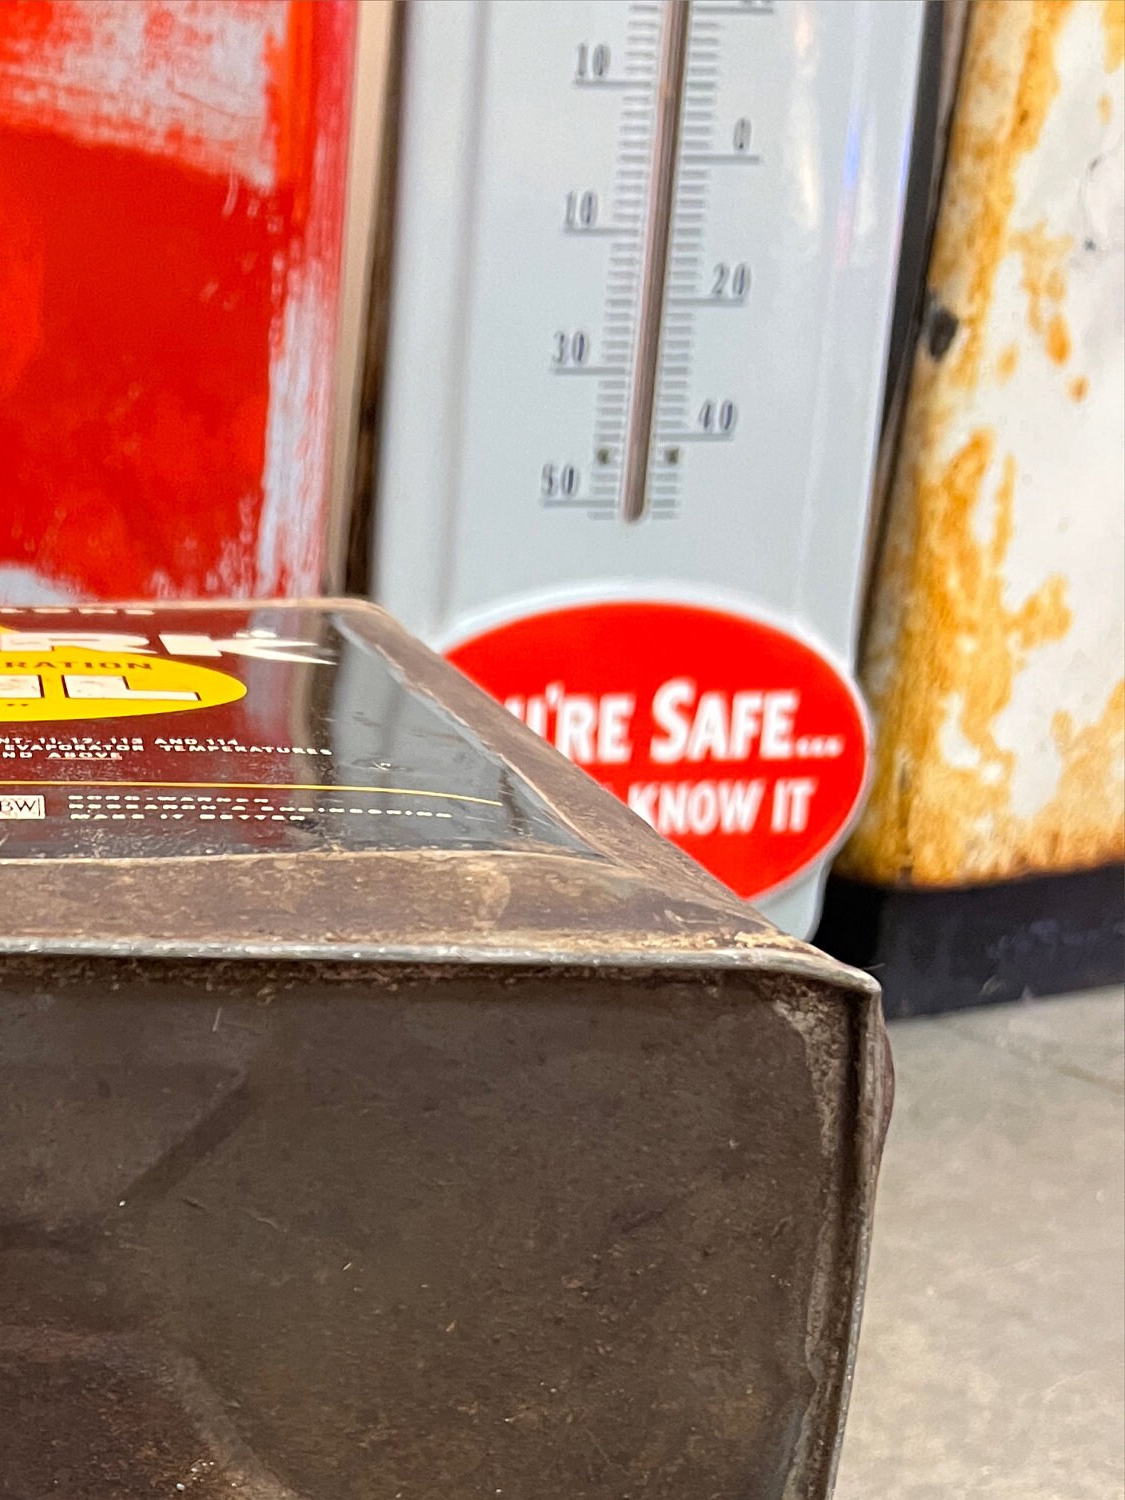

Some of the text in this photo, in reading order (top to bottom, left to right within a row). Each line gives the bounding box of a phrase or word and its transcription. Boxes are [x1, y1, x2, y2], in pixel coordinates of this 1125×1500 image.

[576, 42, 611, 77] 10
[733, 116, 752, 153] 0
[564, 190, 598, 226] 10
[712, 263, 751, 298] 20
[552, 331, 588, 366] 30
[698, 399, 738, 433] 40
[541, 463, 579, 497] 50
[4, 744, 144, 752] EVAPORATOR
[160, 745, 332, 756] TEMPERATURES
[48, 751, 122, 760] ABOVE
[626, 778, 817, 836] KNOW IT
